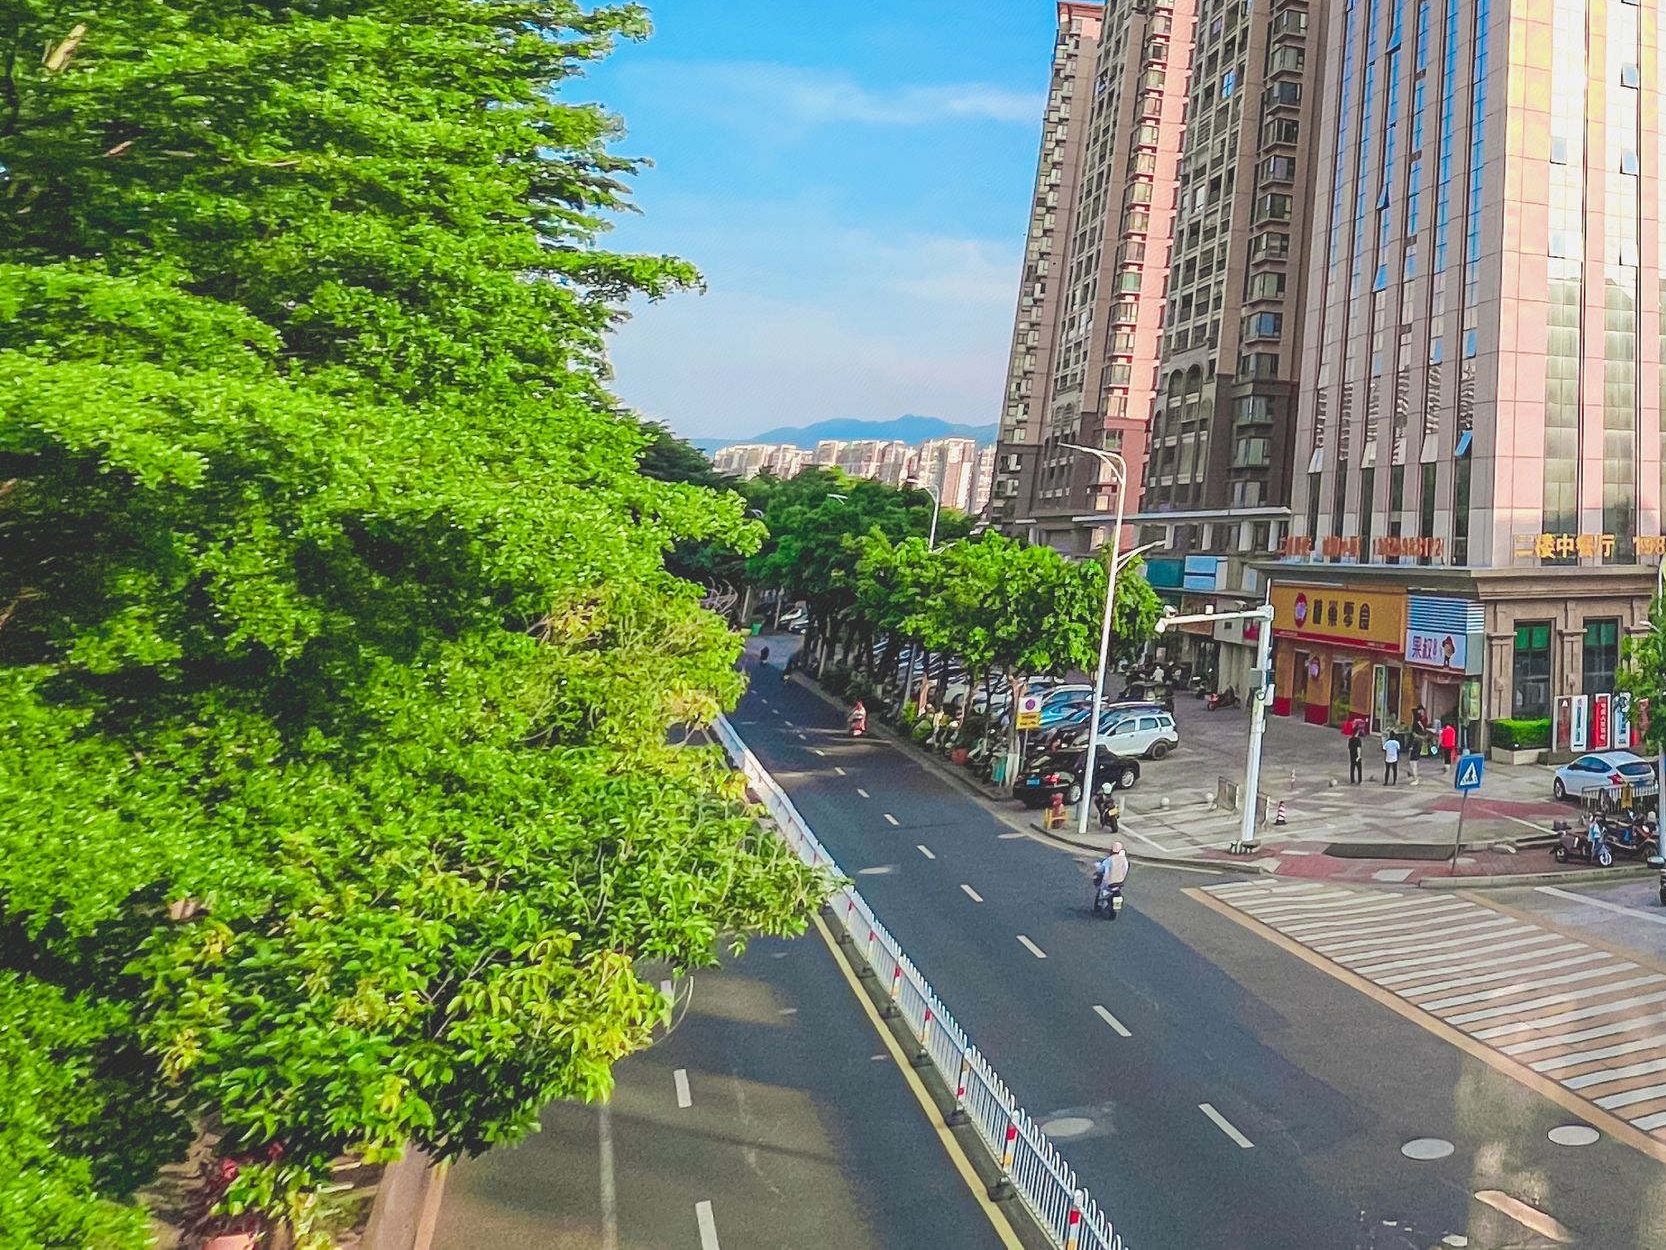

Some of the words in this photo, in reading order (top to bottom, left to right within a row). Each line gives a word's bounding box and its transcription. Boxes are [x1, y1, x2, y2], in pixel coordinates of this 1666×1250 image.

[1514, 533, 1616, 559] 二楼中餐厅
